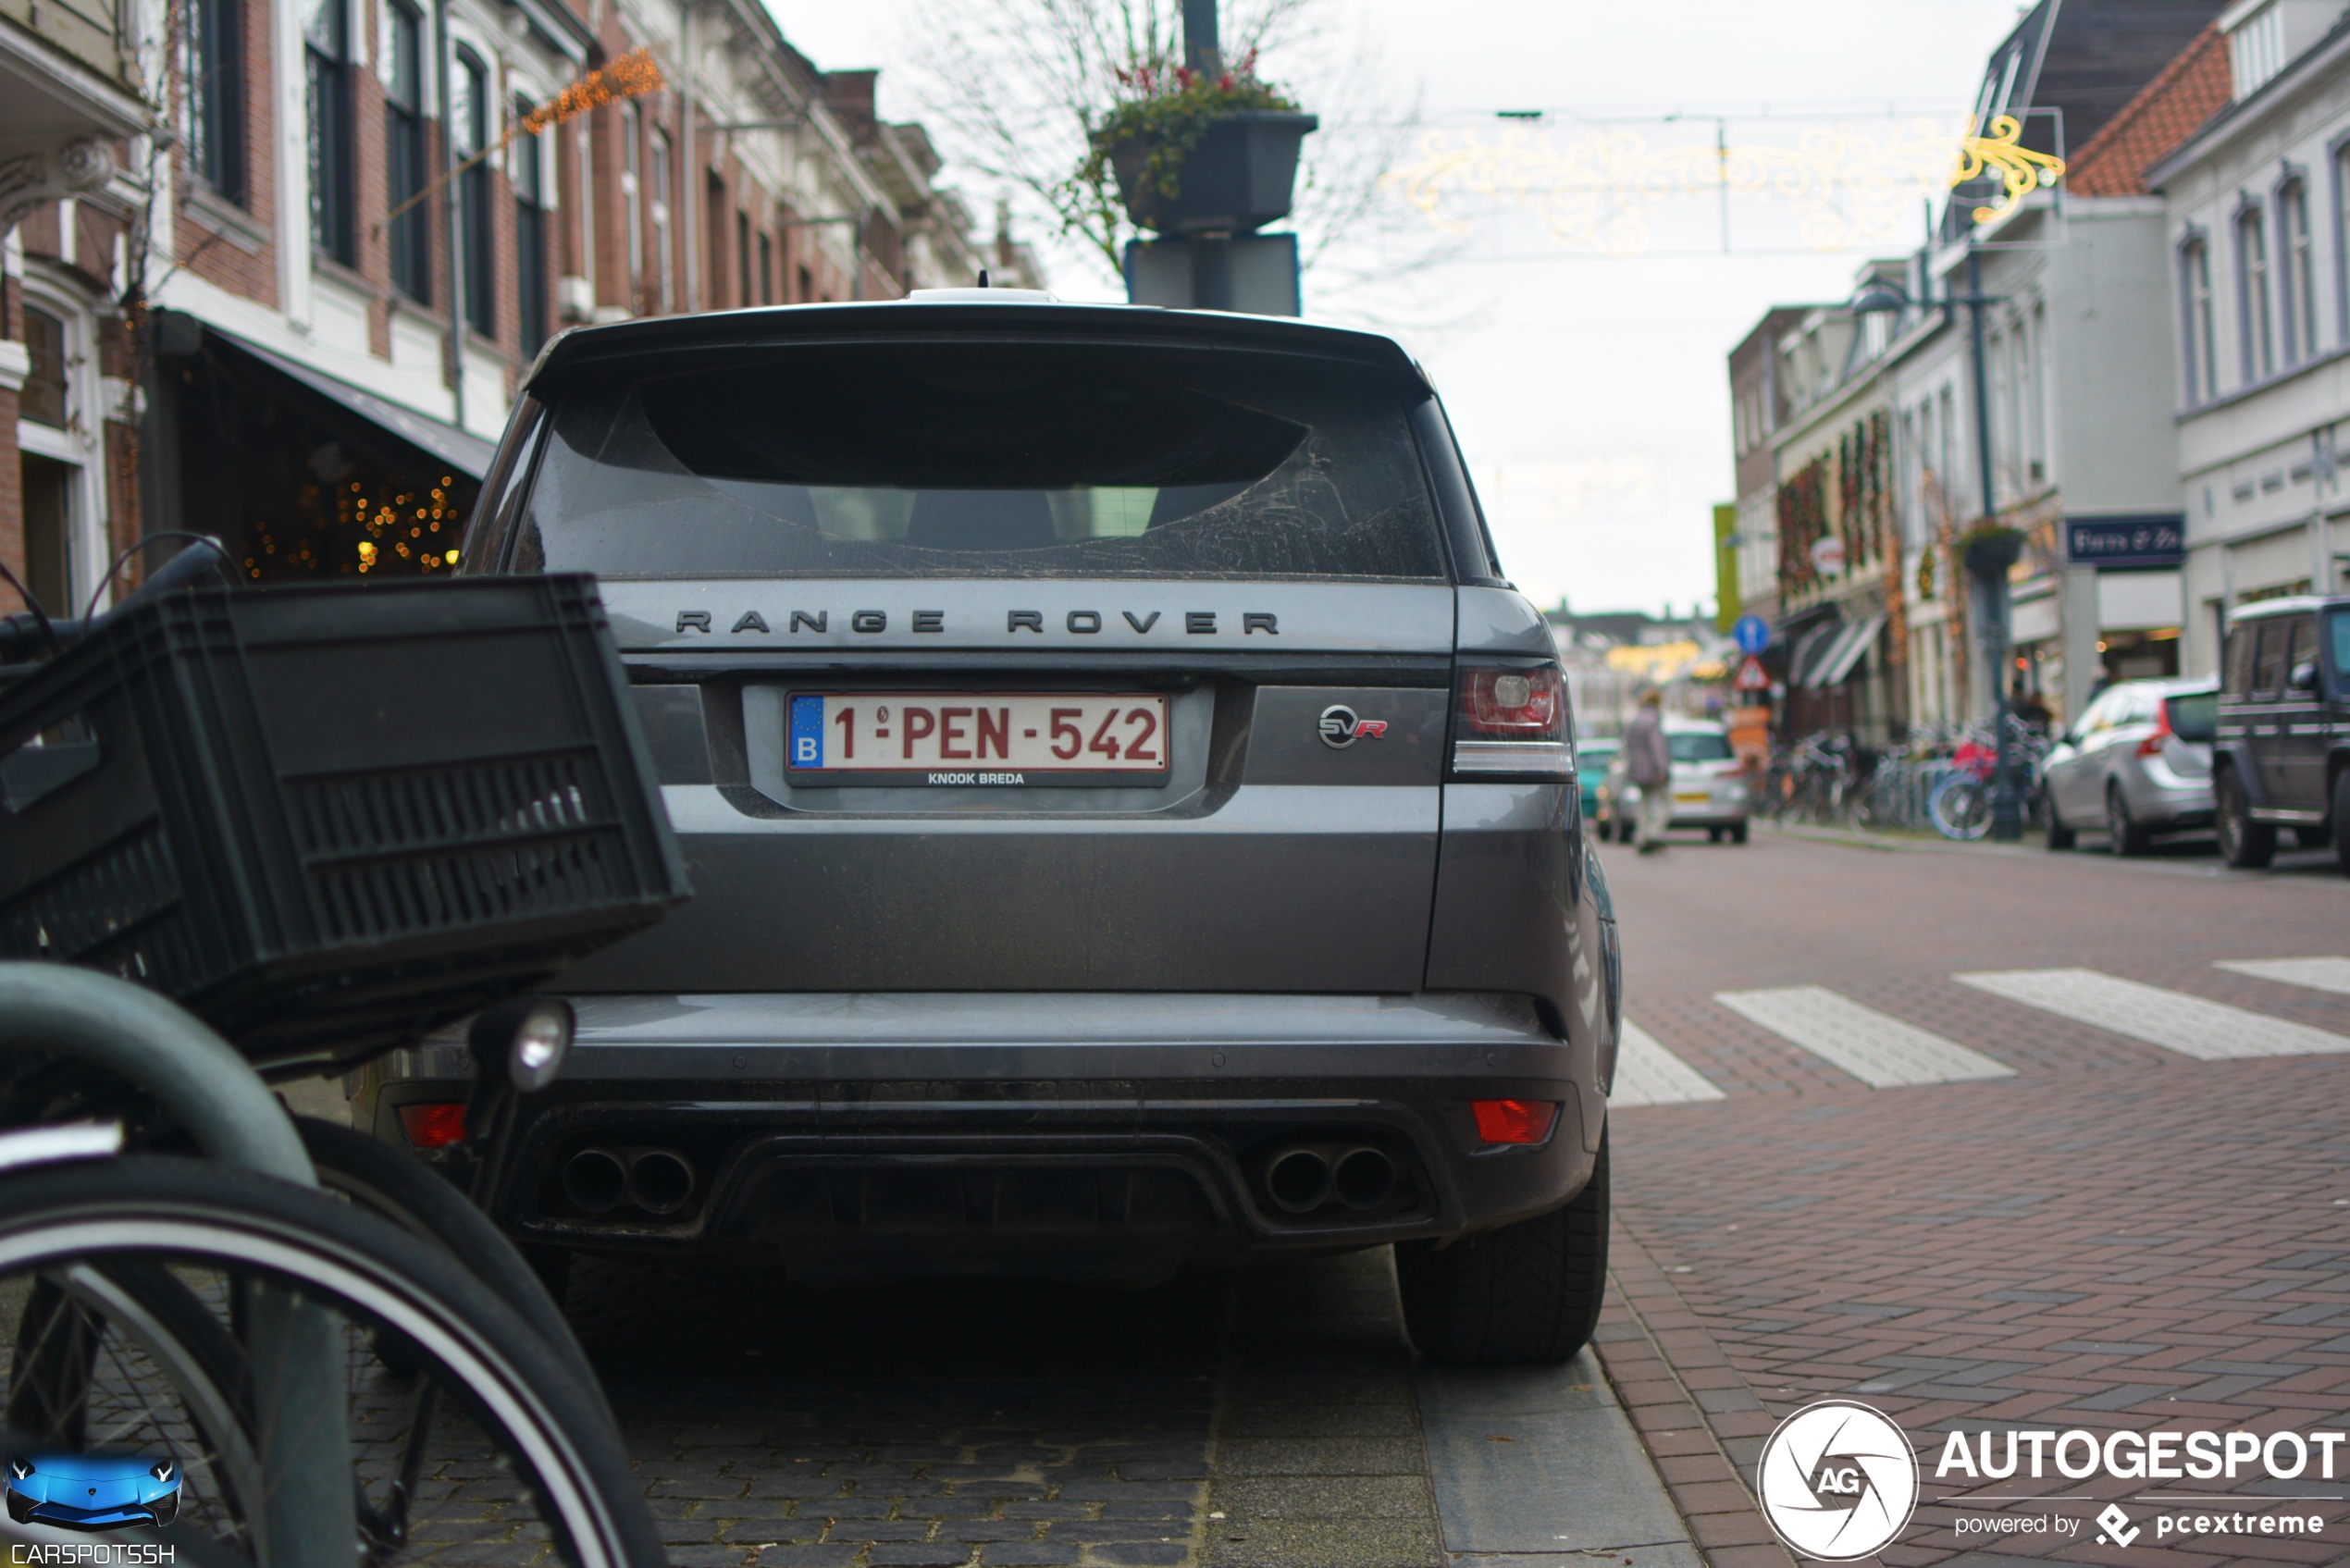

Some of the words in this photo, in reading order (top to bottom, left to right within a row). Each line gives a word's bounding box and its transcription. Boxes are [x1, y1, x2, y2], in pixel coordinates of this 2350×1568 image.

[675, 610, 945, 634] RANGE
[1008, 611, 1280, 635] ROVER
[835, 706, 1157, 760] 1-PEN-542
[1318, 716, 1388, 740] SVR
[797, 737, 818, 761] B
[928, 772, 976, 784] KNOOK
[979, 772, 1025, 784] BREDA
